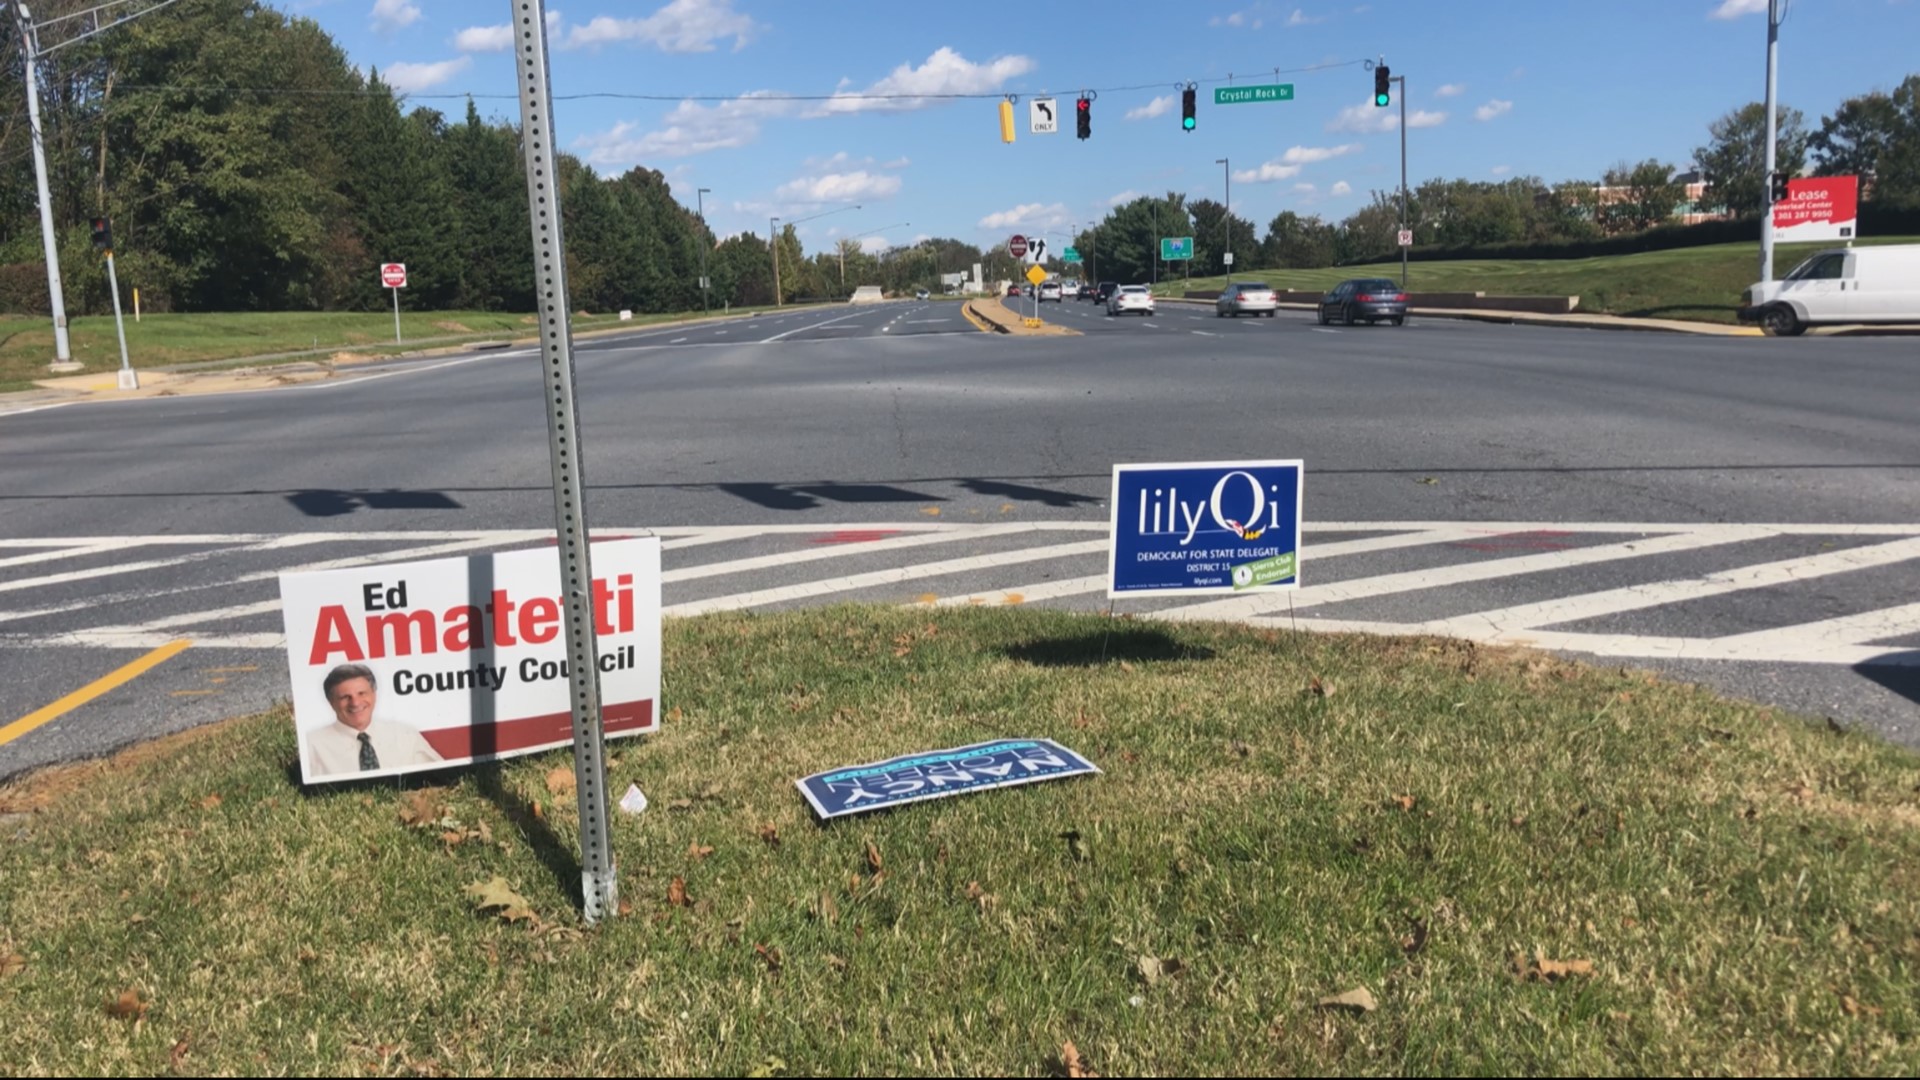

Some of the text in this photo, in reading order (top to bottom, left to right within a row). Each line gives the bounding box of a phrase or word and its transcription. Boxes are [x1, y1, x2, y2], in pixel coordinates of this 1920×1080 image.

[1220, 88, 1288, 101] Crystal Rock Dr
[1035, 123, 1053, 131] ONLY
[1791, 190, 1829, 201] Lease
[1774, 202, 1806, 211] overleaf
[1137, 547, 1279, 561] DEMOCRAT FOR STATE DELEGATE
[1186, 562, 1231, 572] DISTRICT 15
[1252, 556, 1291, 571] Sierra Club
[363, 580, 408, 611] Ed
[309, 573, 634, 665] Amateti
[393, 645, 635, 696] County Coucil
[826, 746, 1051, 793] FLOREEN
[843, 755, 1068, 804] NANCY
